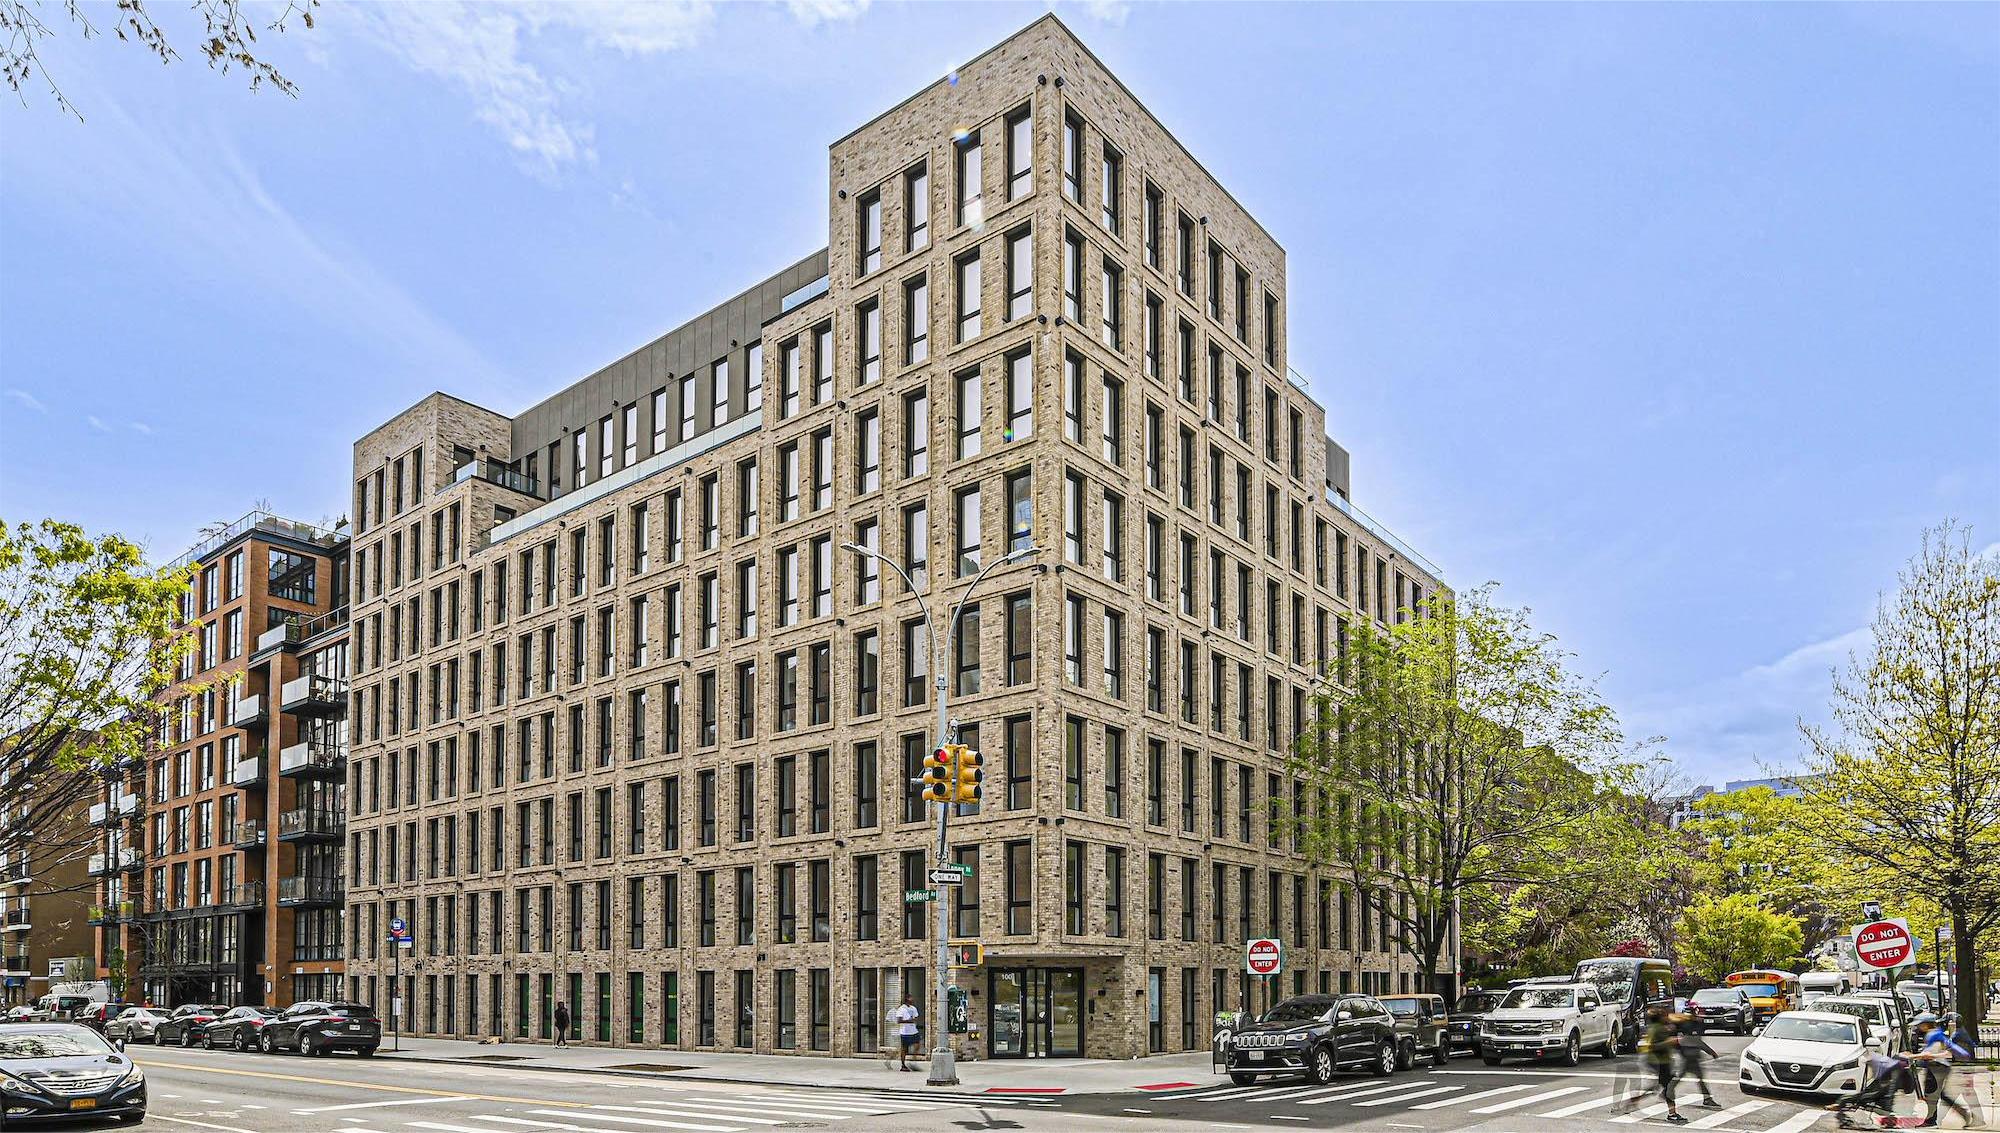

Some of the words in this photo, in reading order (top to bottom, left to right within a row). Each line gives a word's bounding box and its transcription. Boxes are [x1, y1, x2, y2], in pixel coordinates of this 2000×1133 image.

[906, 891, 929, 901] Bedford
[1861, 933, 1875, 942] DO
[1880, 928, 1899, 938] NOT
[1870, 949, 1901, 961] ENTER
